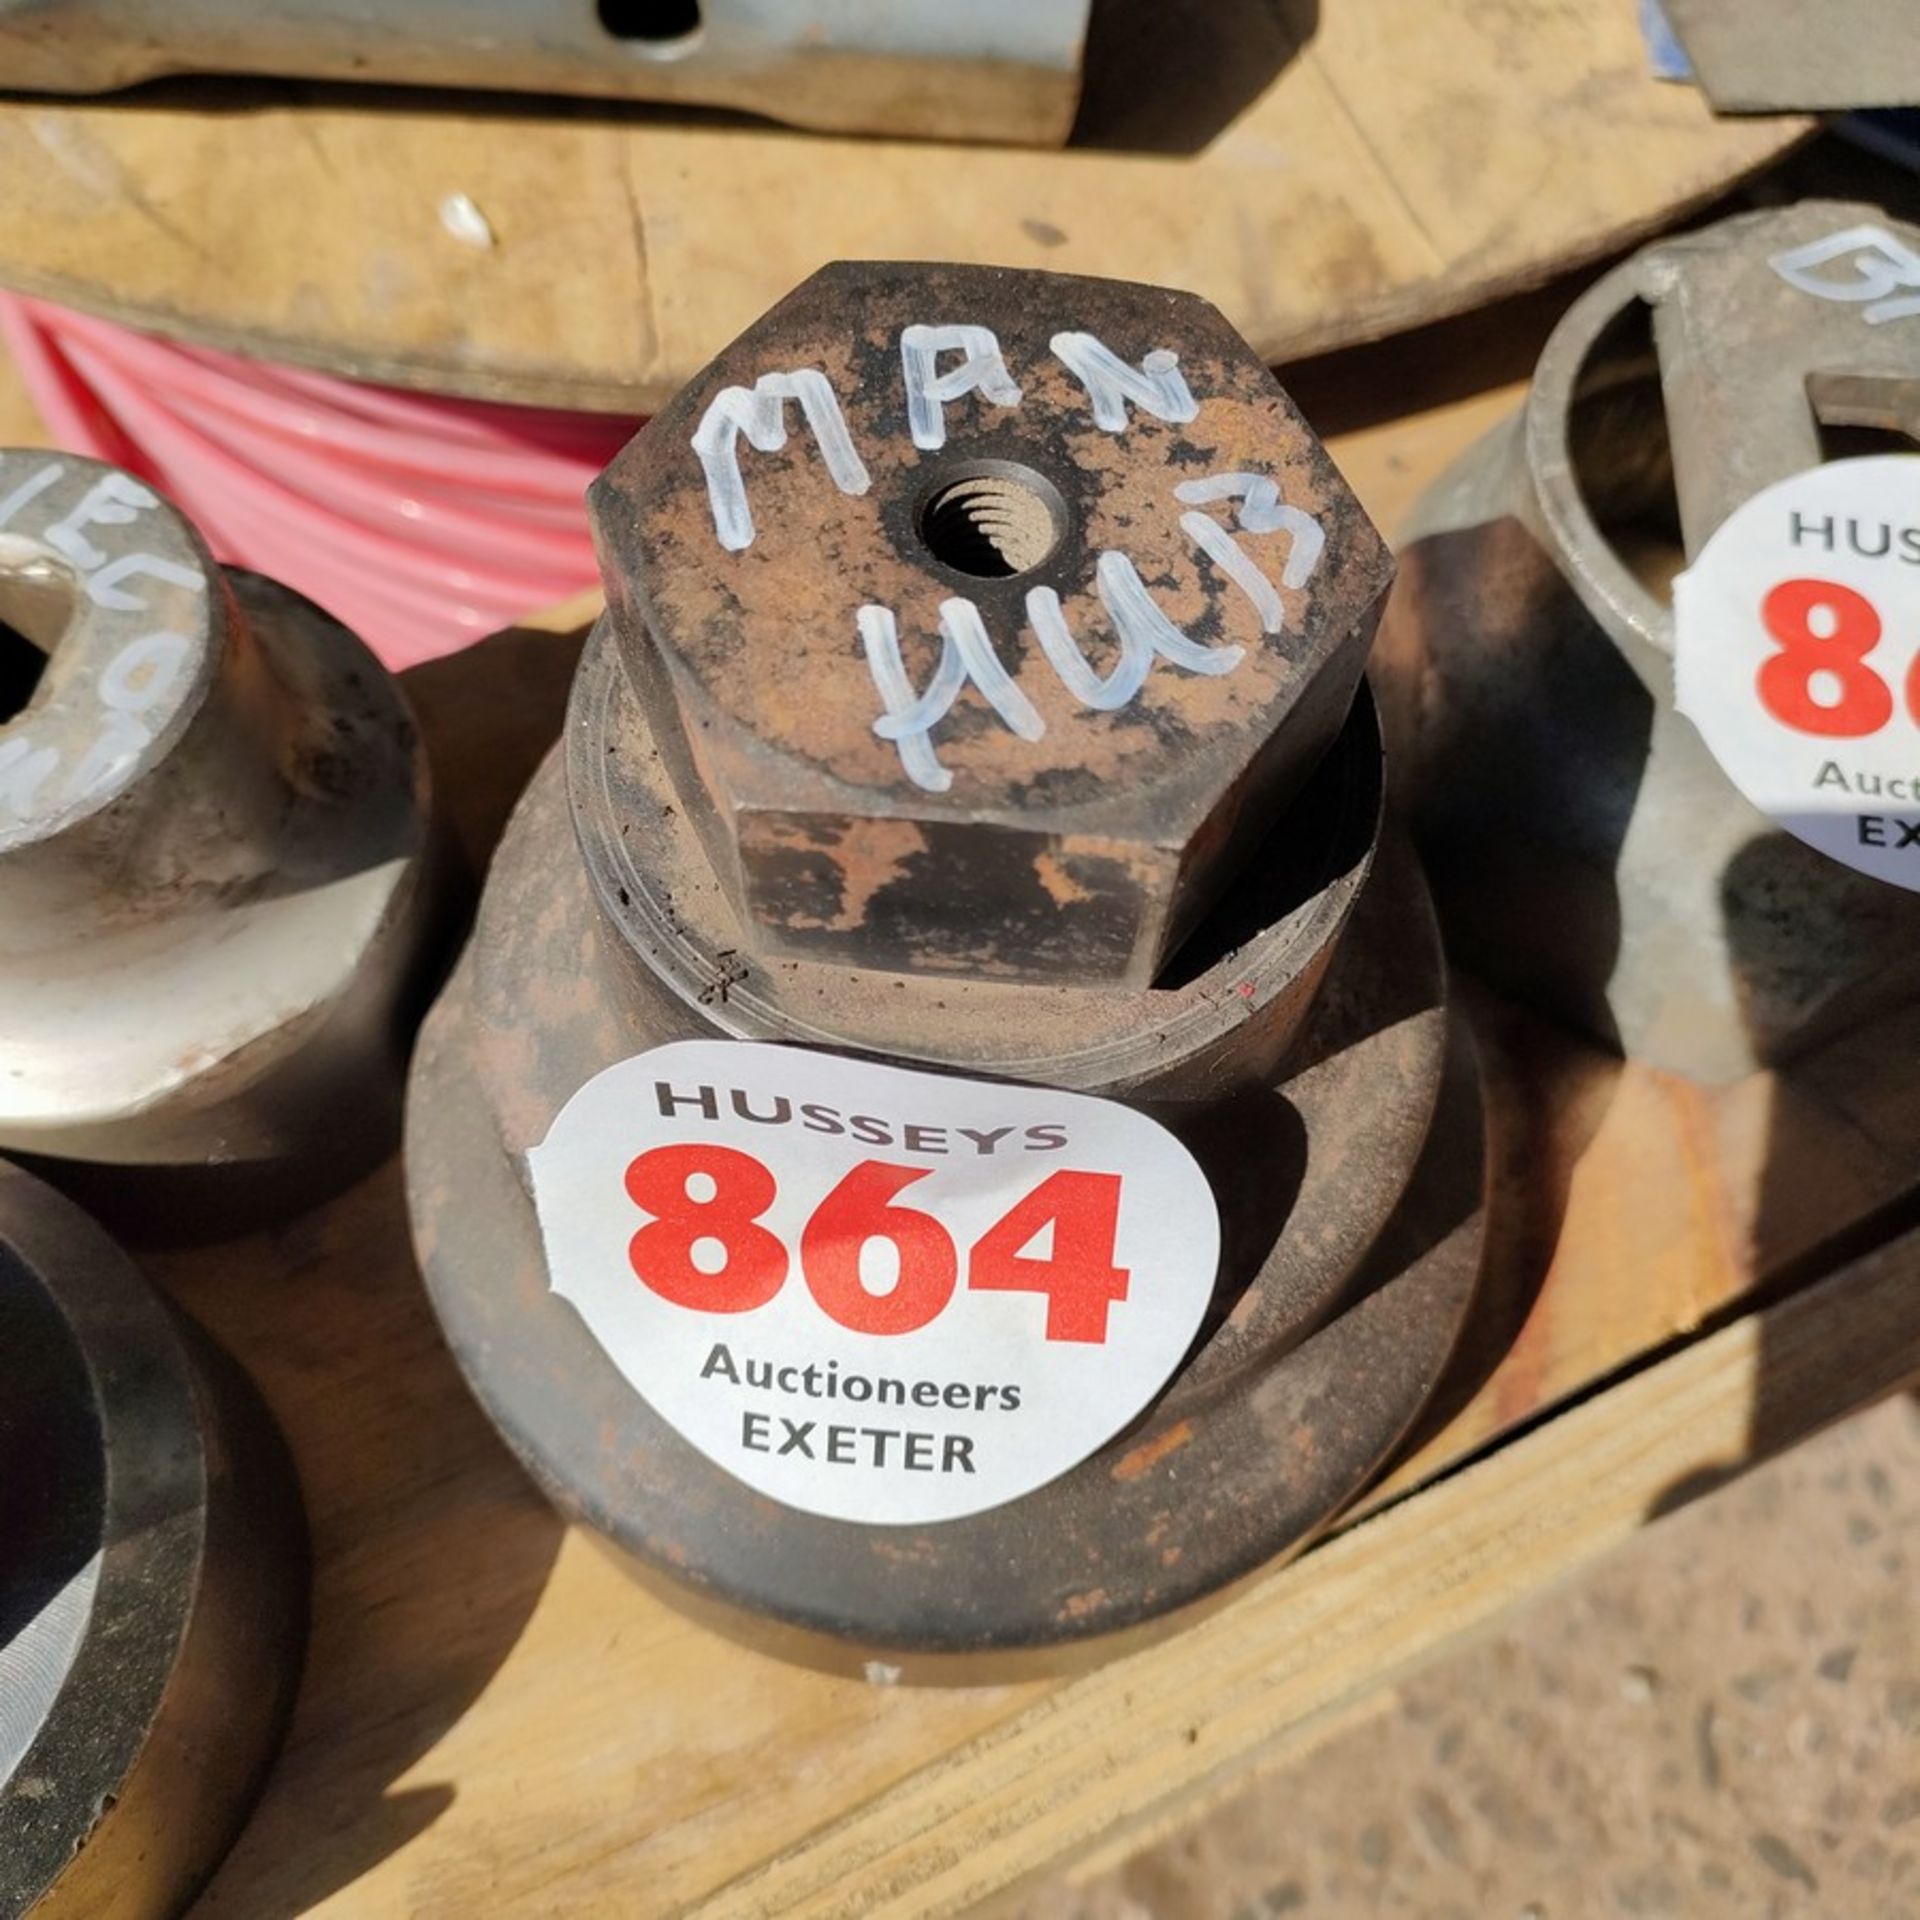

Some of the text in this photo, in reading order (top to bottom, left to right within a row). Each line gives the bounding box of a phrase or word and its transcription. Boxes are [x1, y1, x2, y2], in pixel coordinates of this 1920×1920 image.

[692, 324, 1199, 551] MAN
[857, 472, 1325, 792] HUB
[1754, 578, 1920, 740] 8
[653, 1081, 1069, 1155] HUSSEYS
[624, 1143, 1130, 1344] 864
[699, 1343, 1022, 1412] Auctioneers
[741, 1411, 976, 1474] EXETER
